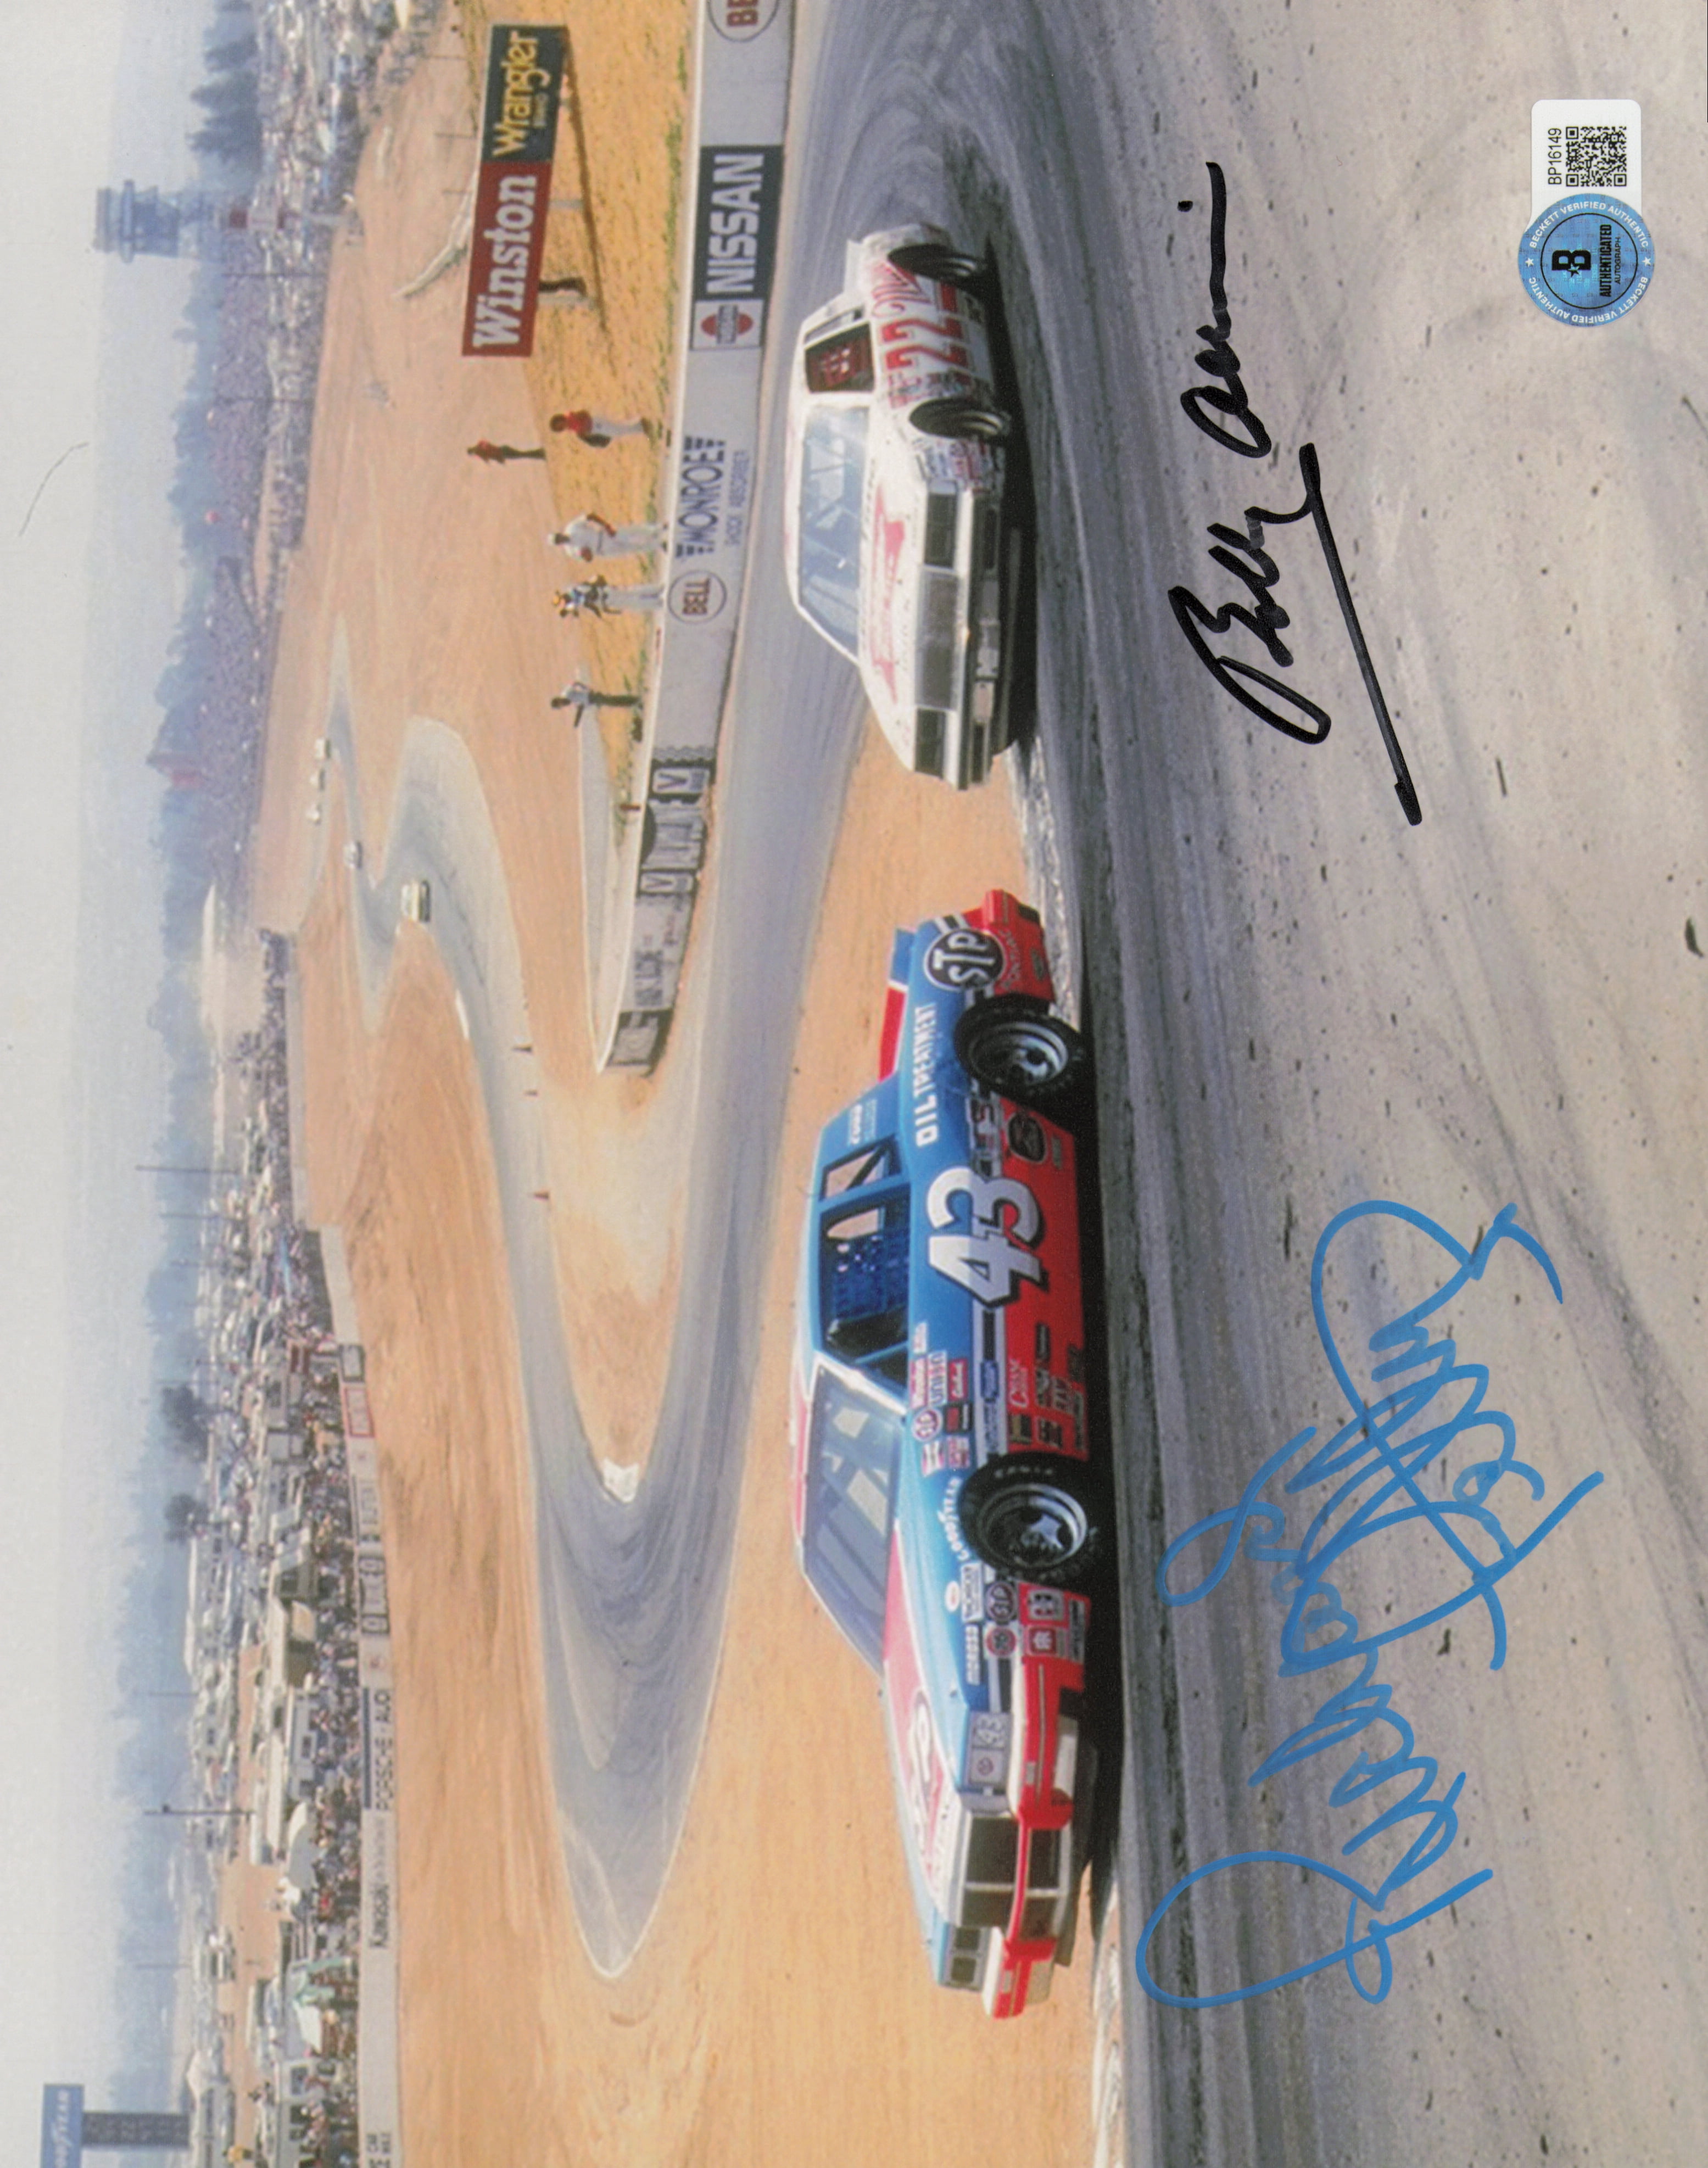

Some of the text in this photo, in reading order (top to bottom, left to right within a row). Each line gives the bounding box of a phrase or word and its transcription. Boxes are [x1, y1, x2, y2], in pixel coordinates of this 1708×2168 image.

[492, 30, 551, 157] Wrangler
[1548, 127, 1562, 185] BP16149
[705, 153, 764, 294] NISSAN
[1530, 201, 1649, 248] BECKETT VERIFIED AUTHENTIC
[471, 176, 537, 349] Winston
[1599, 224, 1612, 297] AUTHENTICATED
[1528, 277, 1648, 324] BECKETT VERIFIED AUTHENTIC
[881, 318, 973, 370] 22
[678, 450, 724, 545] MONROE
[682, 578, 711, 617] BELL
[932, 931, 997, 985] STP
[912, 1003, 938, 1147] OIL TREATMENT
[925, 1165, 1045, 1303] 43
[937, 1476, 970, 1561] GOODYEAR
[375, 1738, 393, 1810] PORSCHE
